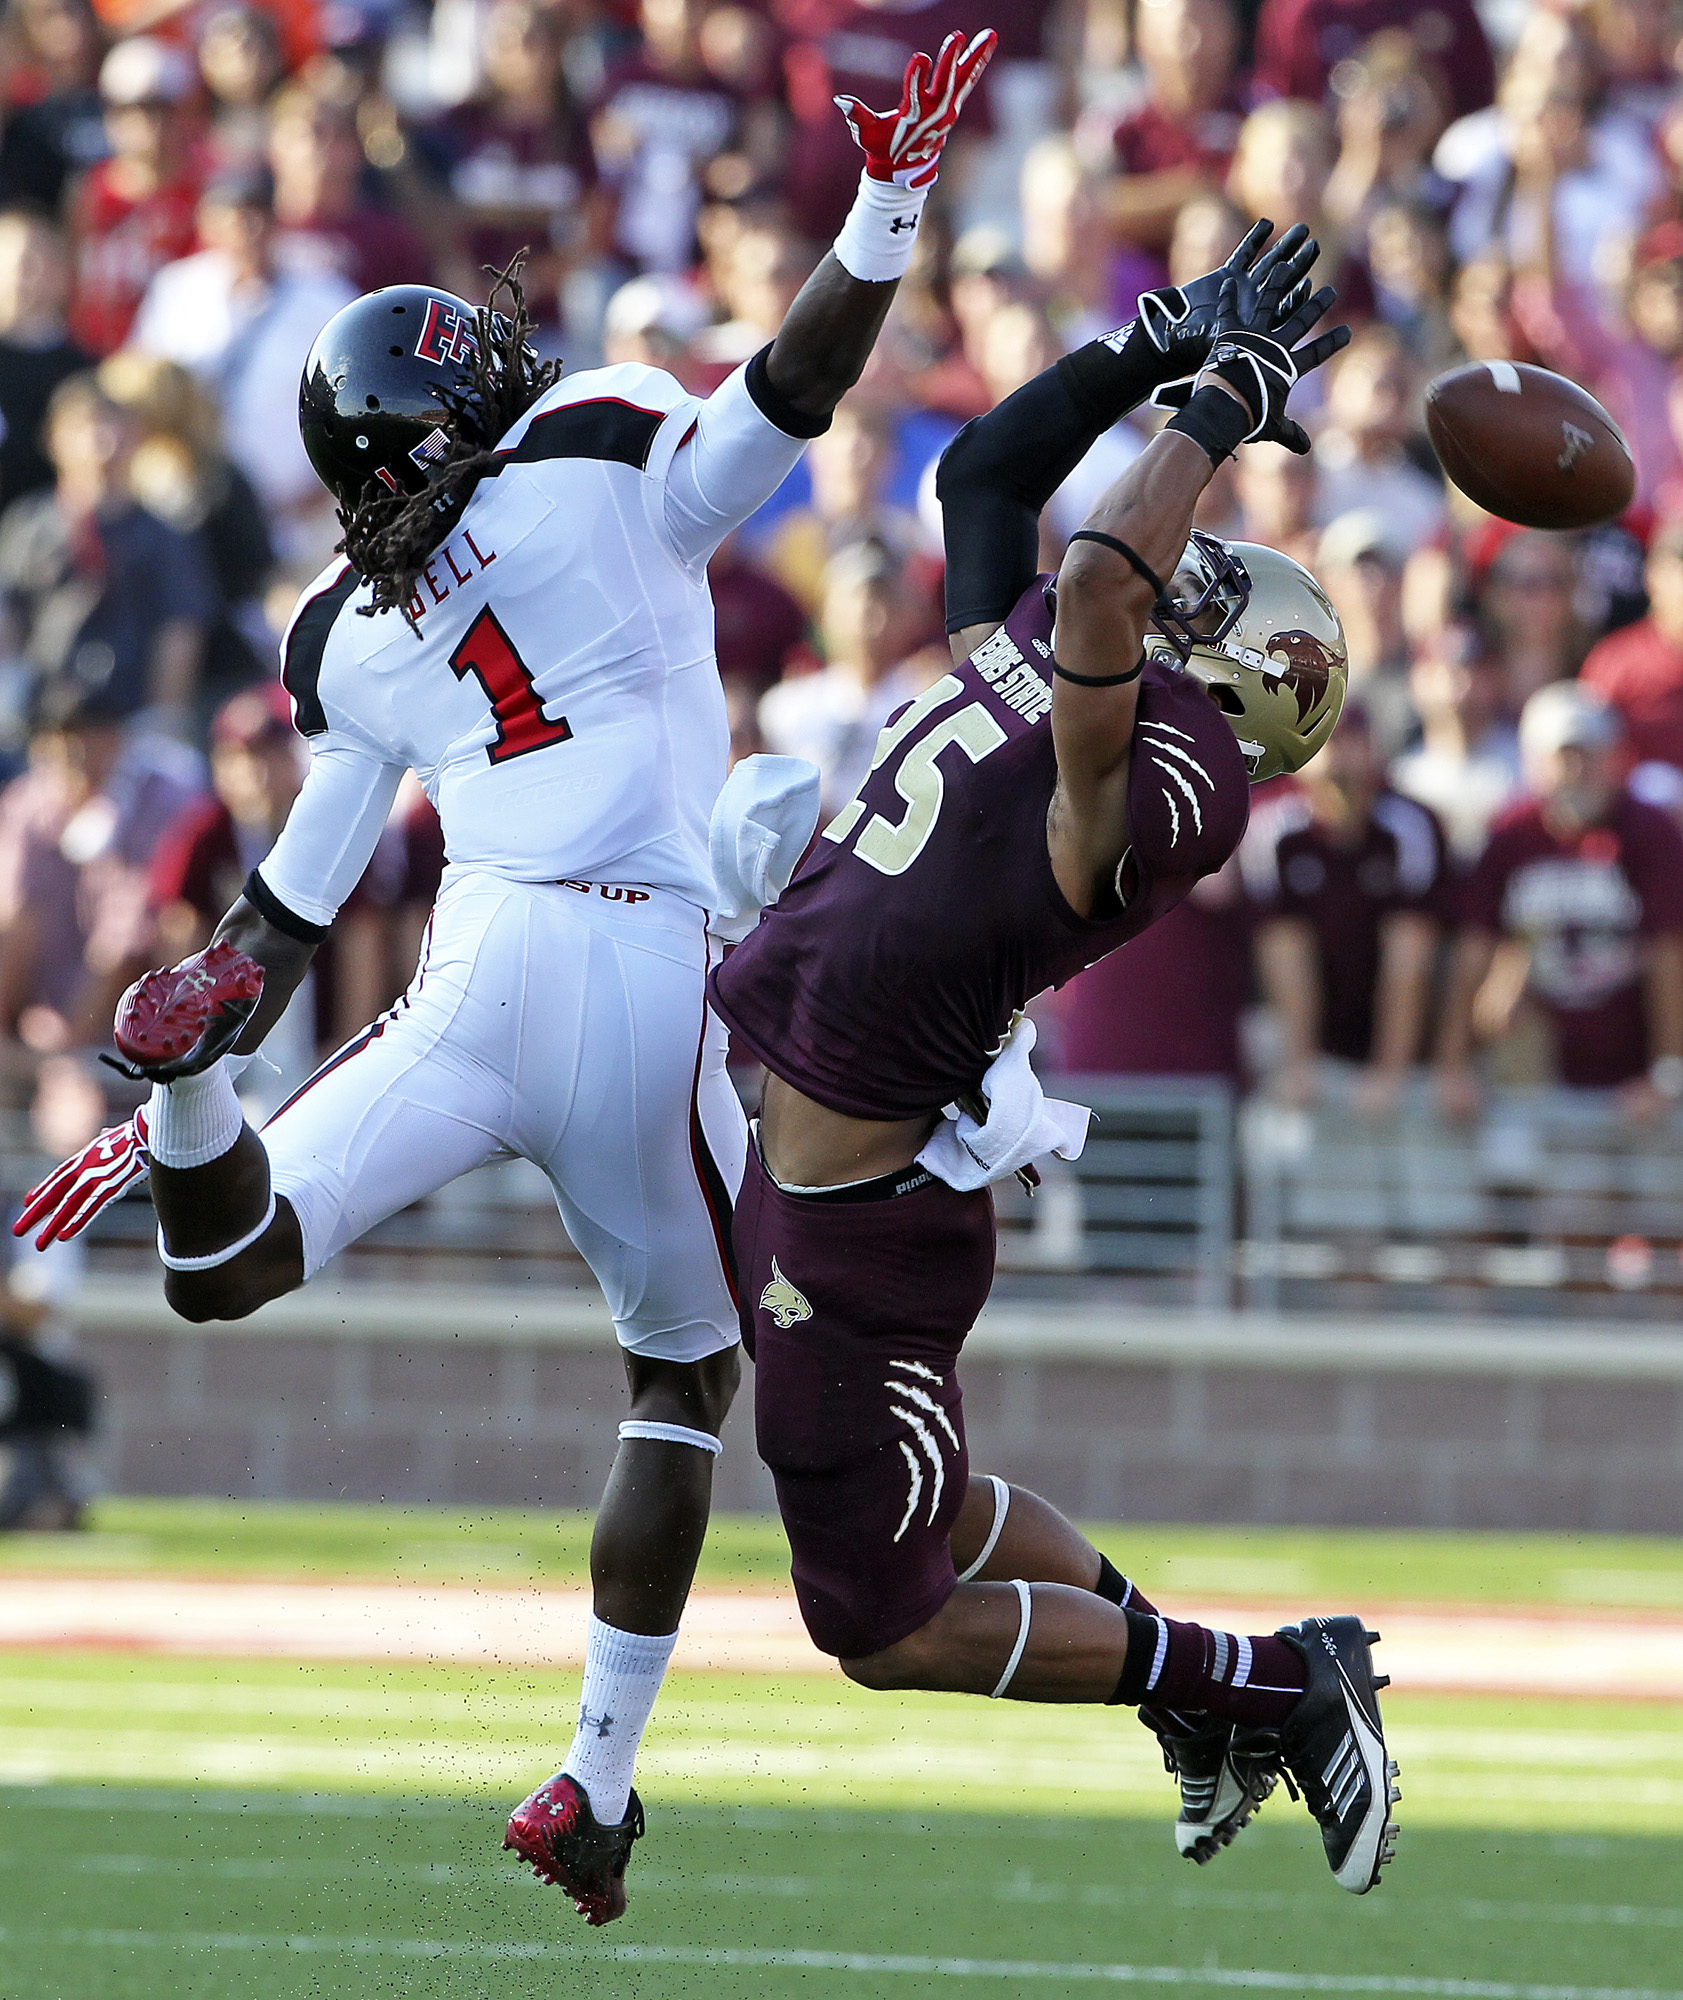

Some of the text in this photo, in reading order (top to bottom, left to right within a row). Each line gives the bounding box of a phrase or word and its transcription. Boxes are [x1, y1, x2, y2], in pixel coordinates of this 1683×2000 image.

[447, 602, 574, 766] 1
[968, 623, 1054, 726] TEXAS STATE
[600, 884, 651, 905] UP
